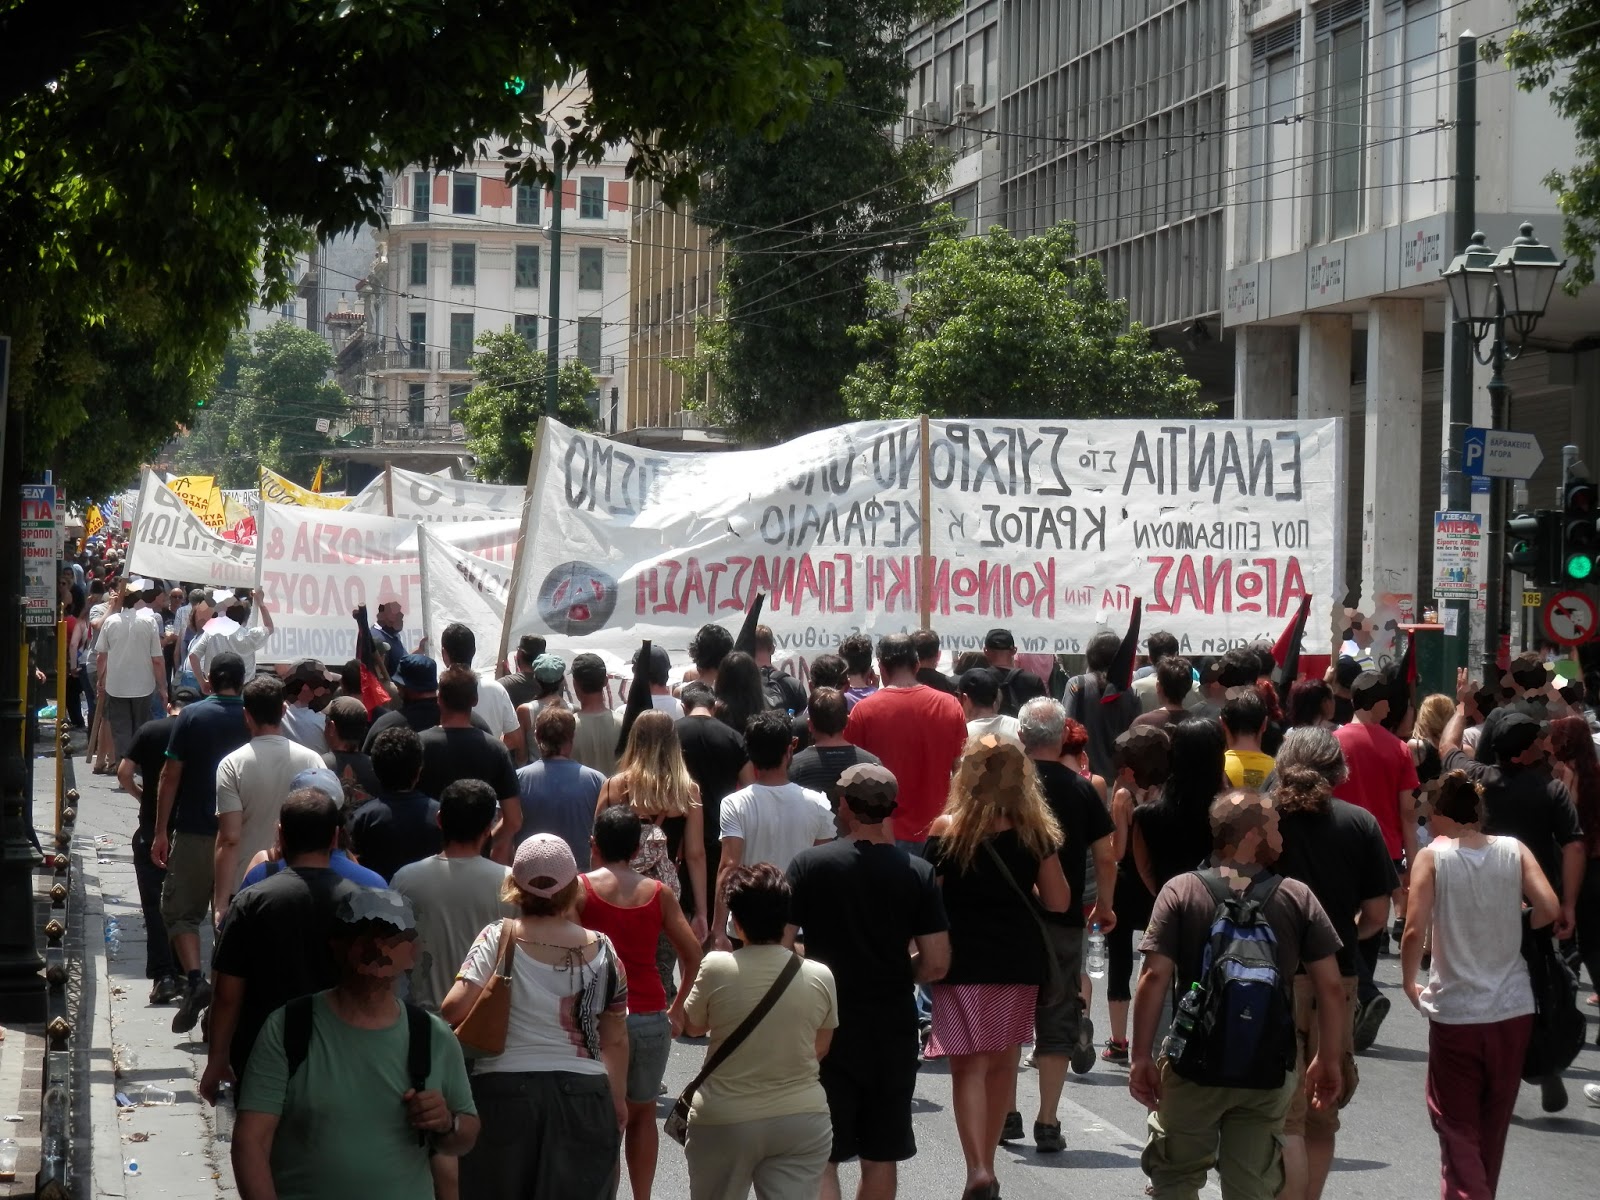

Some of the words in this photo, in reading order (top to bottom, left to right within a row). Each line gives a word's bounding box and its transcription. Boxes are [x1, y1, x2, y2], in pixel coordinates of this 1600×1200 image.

[1490, 440, 1531, 449] ΒΑΡΒΑΚΕΙΟΣ
[1467, 443, 1482, 467] P
[1490, 450, 1512, 458] ΑΓΟΡΑ
[21, 529, 53, 539] ΘΡΩΠΟΙ
[24, 548, 53, 558] ΙΘΜΟΙ!
[1522, 593, 1541, 605] 185
